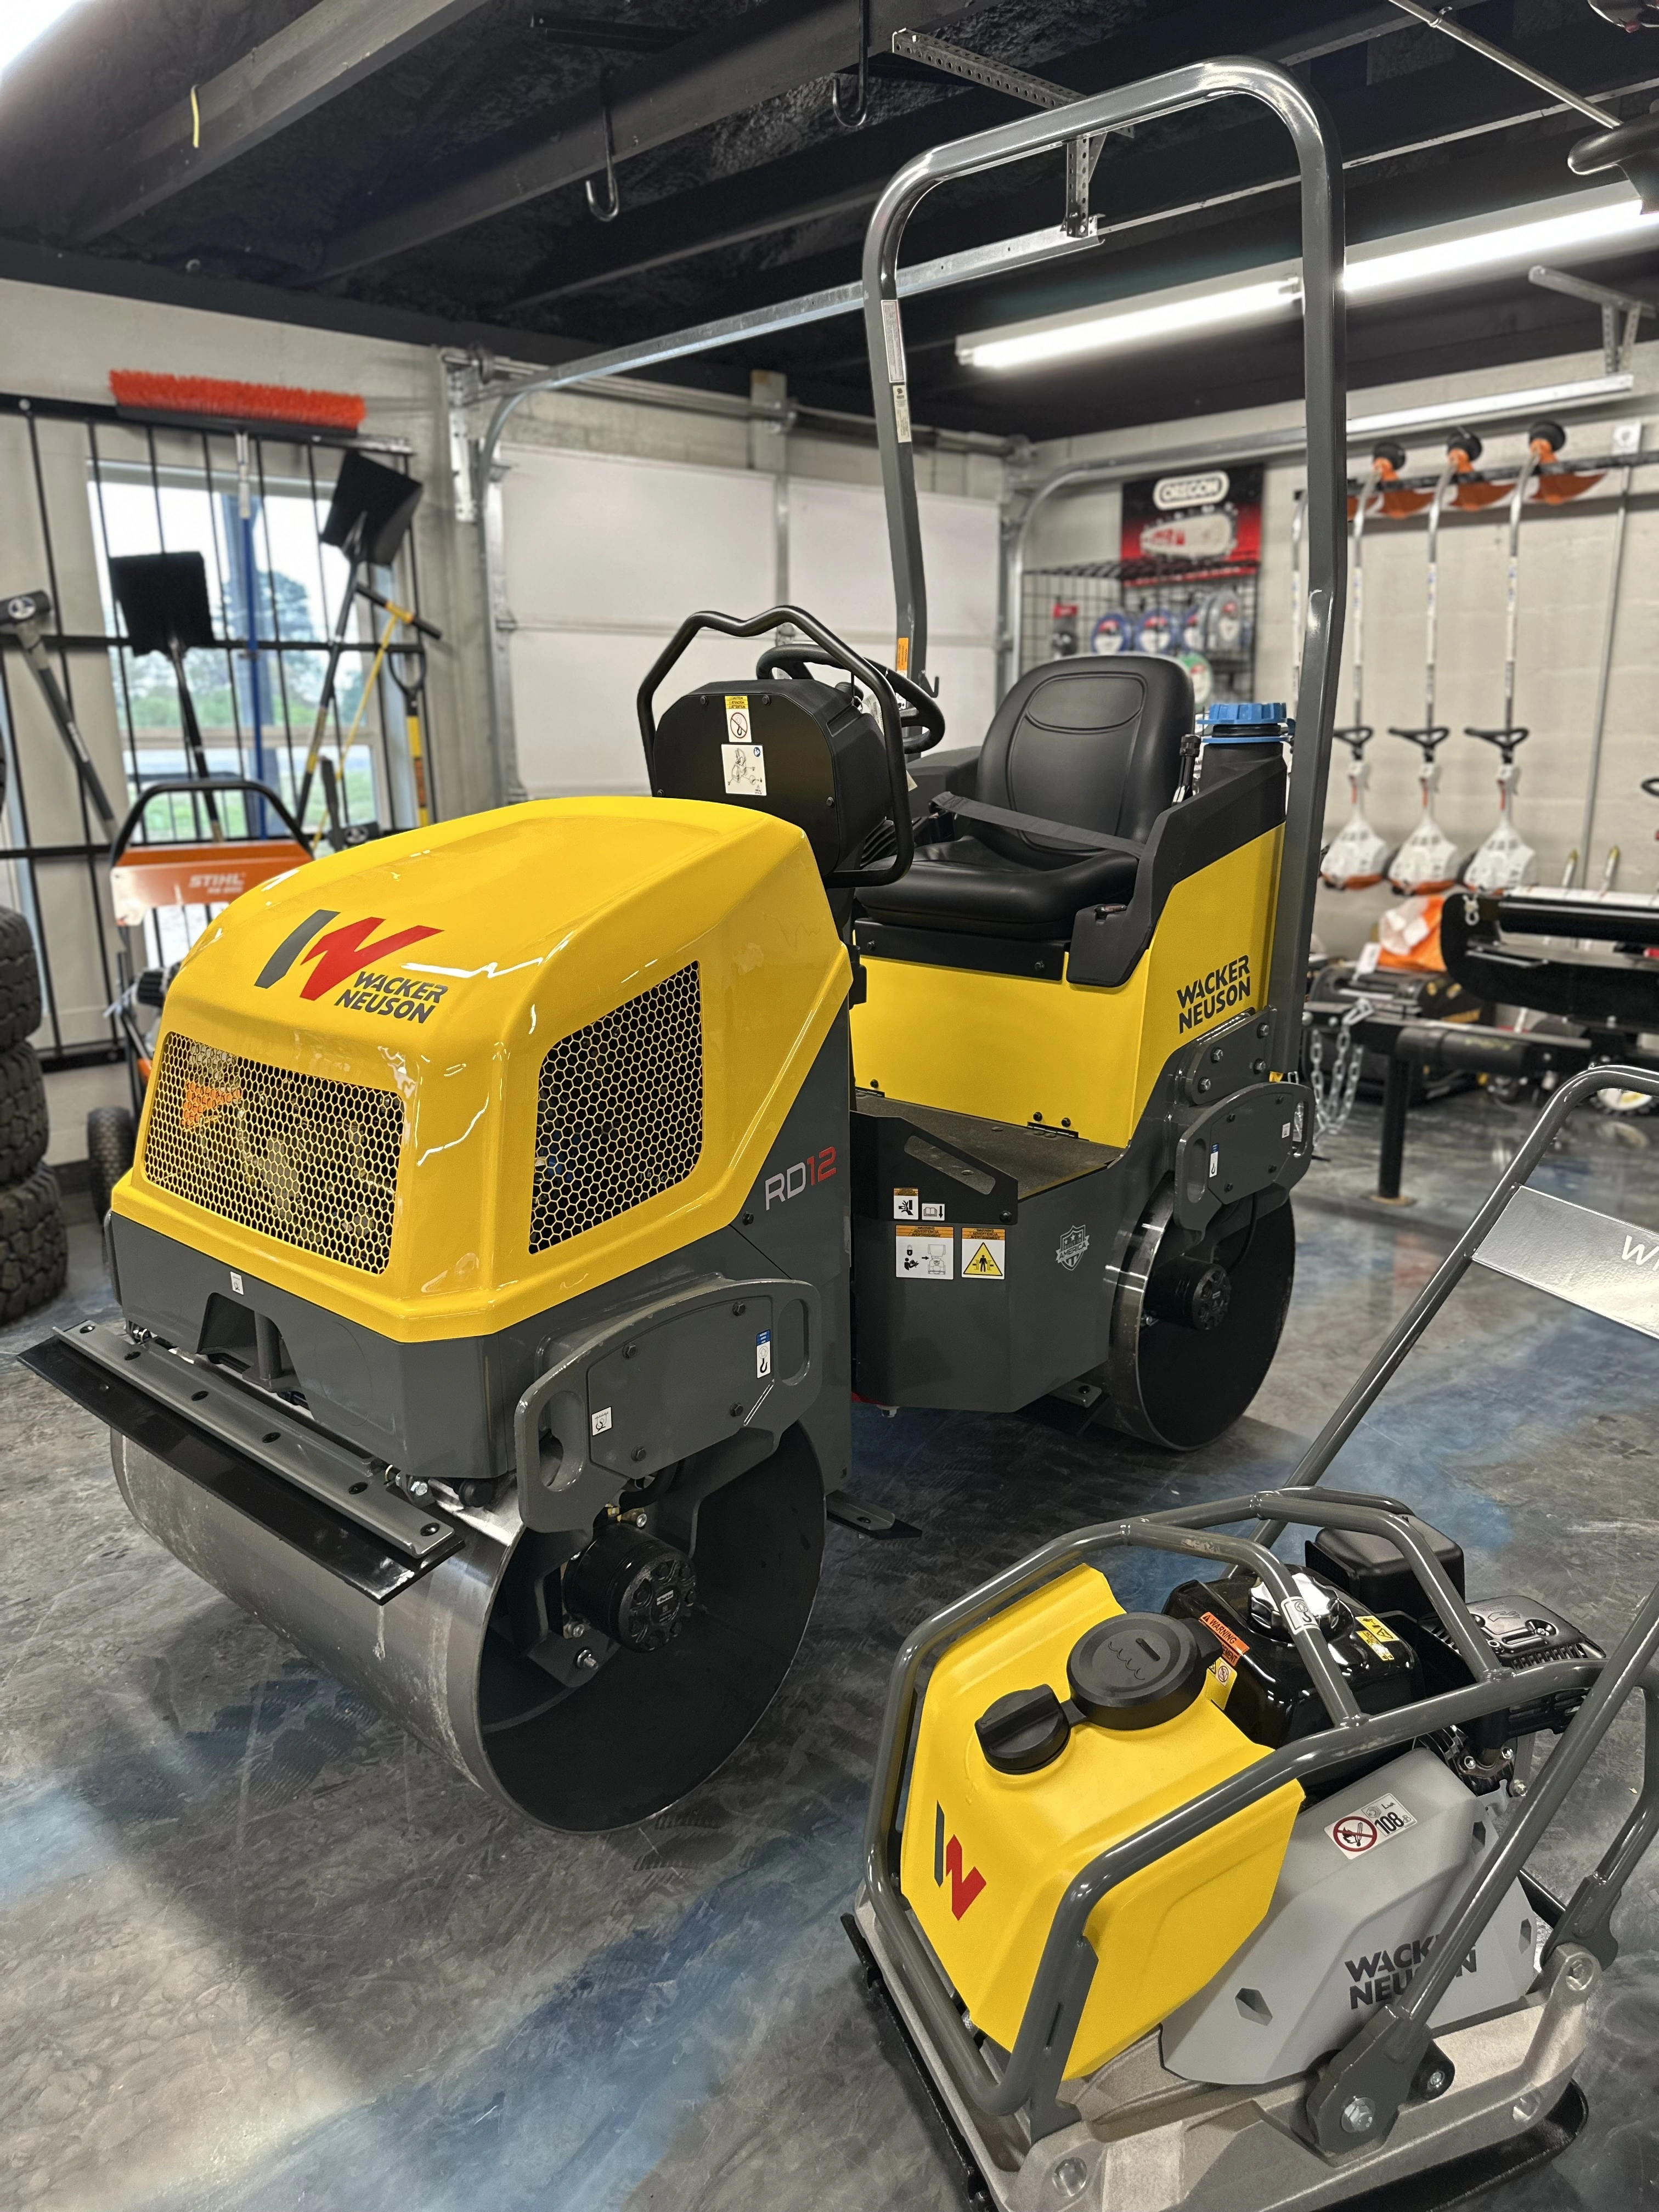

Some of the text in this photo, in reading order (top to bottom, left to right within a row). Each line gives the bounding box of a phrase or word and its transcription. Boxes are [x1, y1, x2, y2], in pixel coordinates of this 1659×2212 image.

[188, 873, 245, 888] STIHL
[353, 970, 449, 1004] WACKER
[1176, 955, 1250, 1009] WACKER
[333, 989, 436, 1024] NEUSON
[1178, 975, 1251, 1035] NEUSON
[765, 1146, 837, 1211] RD12
[1059, 1242, 1087, 1259] AMERICA
[1621, 1234, 1659, 1272] W
[1210, 1618, 1237, 1644] WARNING
[1374, 1812, 1404, 1834] 108
[1349, 1949, 1477, 2010] NEUN
